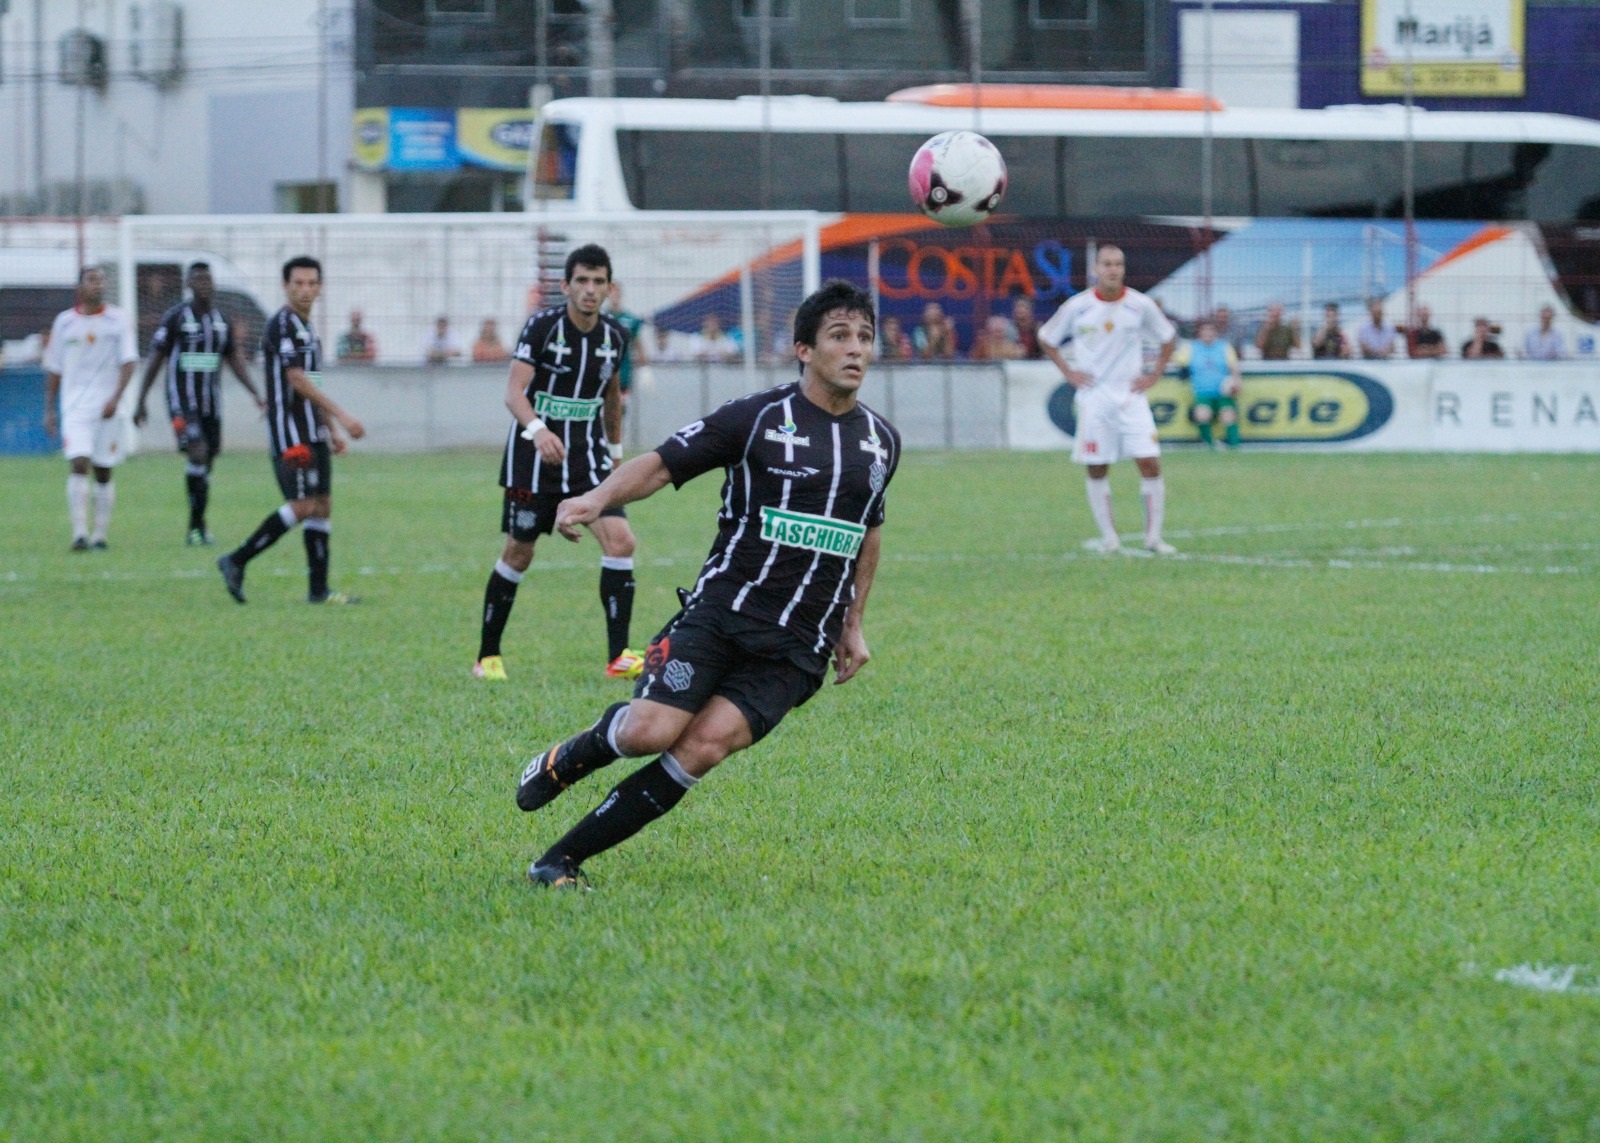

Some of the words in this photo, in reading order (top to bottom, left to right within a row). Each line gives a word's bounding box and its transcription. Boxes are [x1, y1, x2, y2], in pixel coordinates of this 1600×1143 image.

[879, 238, 1036, 299] COSTA
[1435, 391, 1600, 427] RENA
[766, 466, 809, 478] PENALTY
[762, 507, 865, 556] TASCHIBRA
